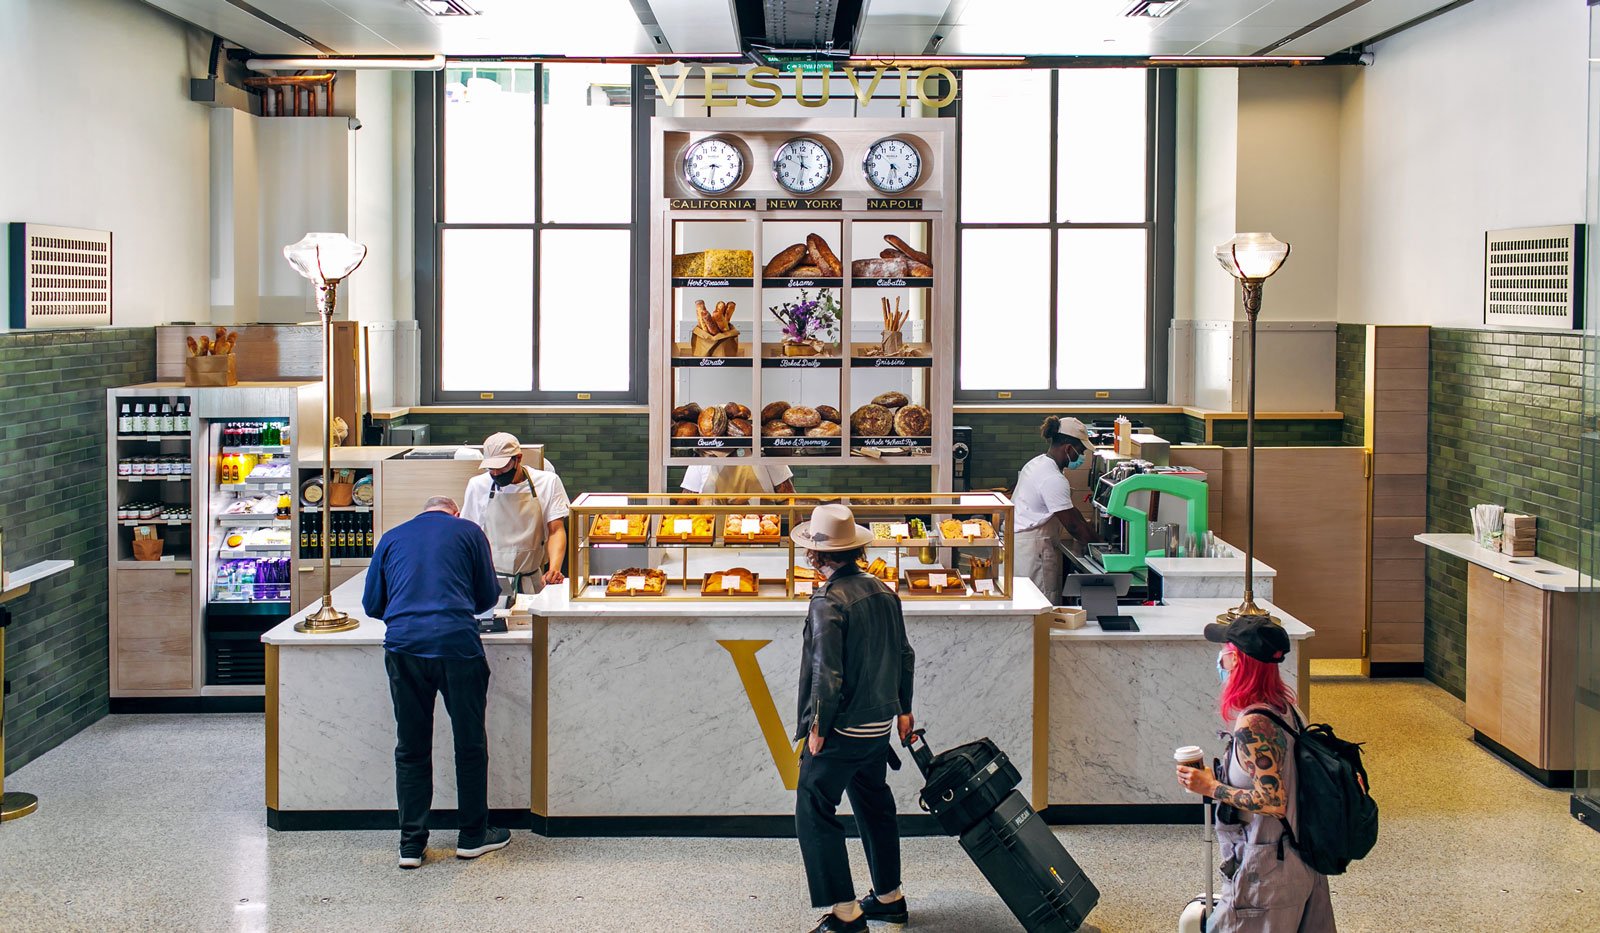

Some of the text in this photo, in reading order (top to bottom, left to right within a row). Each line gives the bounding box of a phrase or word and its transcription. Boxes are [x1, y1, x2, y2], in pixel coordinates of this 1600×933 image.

[646, 66, 958, 108] VESUVIO
[672, 199, 752, 209] CALIFORNIA
[770, 199, 838, 209] NEW YORK
[870, 200, 919, 209] NAPOLI
[687, 279, 703, 287] Herb
[787, 279, 815, 287] Sesame
[876, 278, 907, 287] Ciabatta
[780, 359, 820, 368] Baked Daily
[875, 358, 906, 367] Grissini
[697, 438, 724, 447] Country
[773, 438, 791, 446] Olive
[798, 438, 831, 447] Rosemary
[864, 438, 918, 447] Whole Wheat Rye
[1014, 809, 1031, 826] PELICAN
